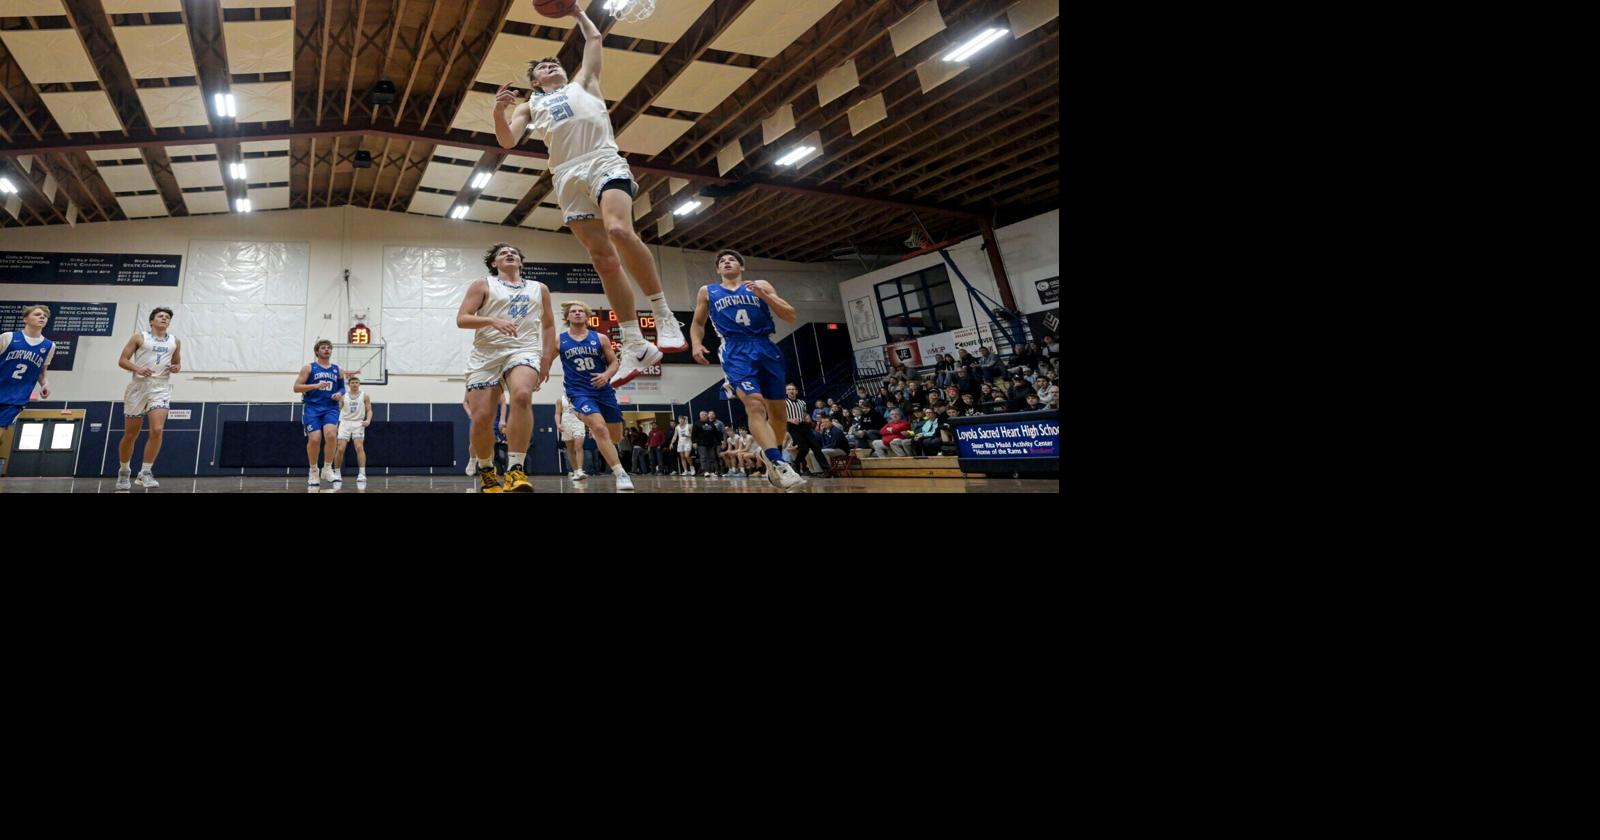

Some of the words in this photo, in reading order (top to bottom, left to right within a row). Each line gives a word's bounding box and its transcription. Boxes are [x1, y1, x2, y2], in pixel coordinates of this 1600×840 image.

[552, 102, 574, 122] 21
[640, 317, 655, 327] 05
[736, 309, 750, 326] 4
[6, 350, 43, 368] CORVALLIS
[564, 346, 599, 360] CORVALLIS
[12, 364, 27, 379] 2
[574, 357, 595, 371] 30
[956, 428, 977, 441] Loyola
[978, 427, 1000, 439] Sacred
[1000, 426, 1020, 438] Heart
[1020, 424, 1039, 439] High
